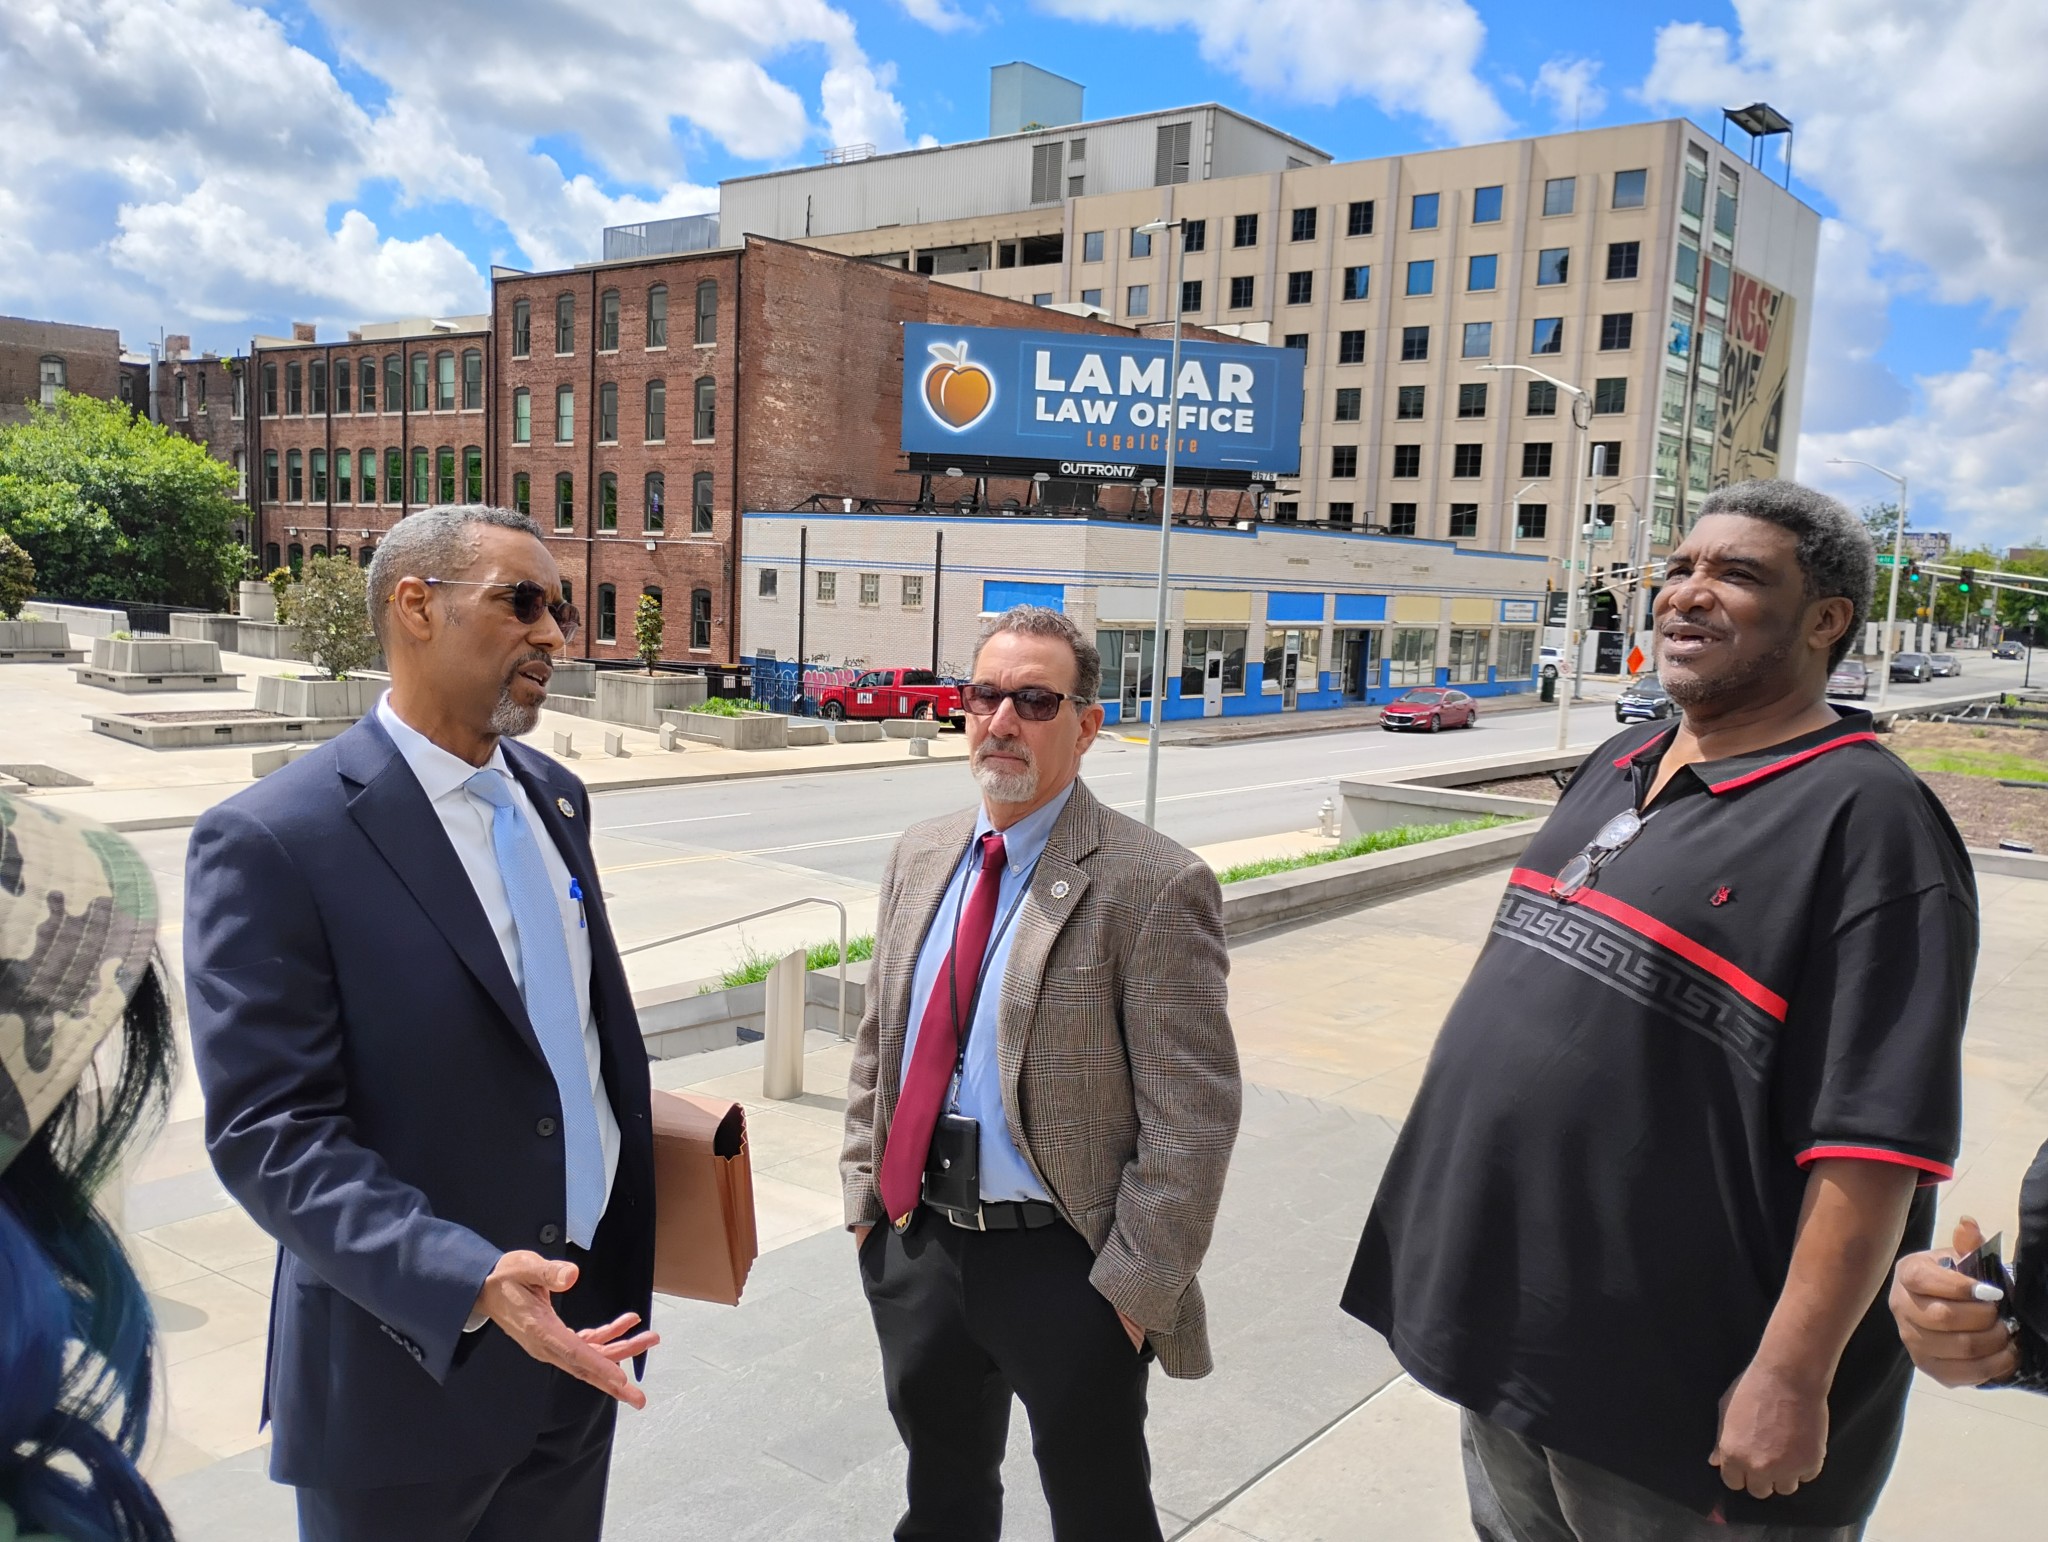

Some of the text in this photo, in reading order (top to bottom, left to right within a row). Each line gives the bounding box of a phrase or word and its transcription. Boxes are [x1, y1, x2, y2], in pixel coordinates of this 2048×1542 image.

[1035, 350, 1254, 403] LAMAR
[1036, 397, 1254, 433] LAW OFFICE
